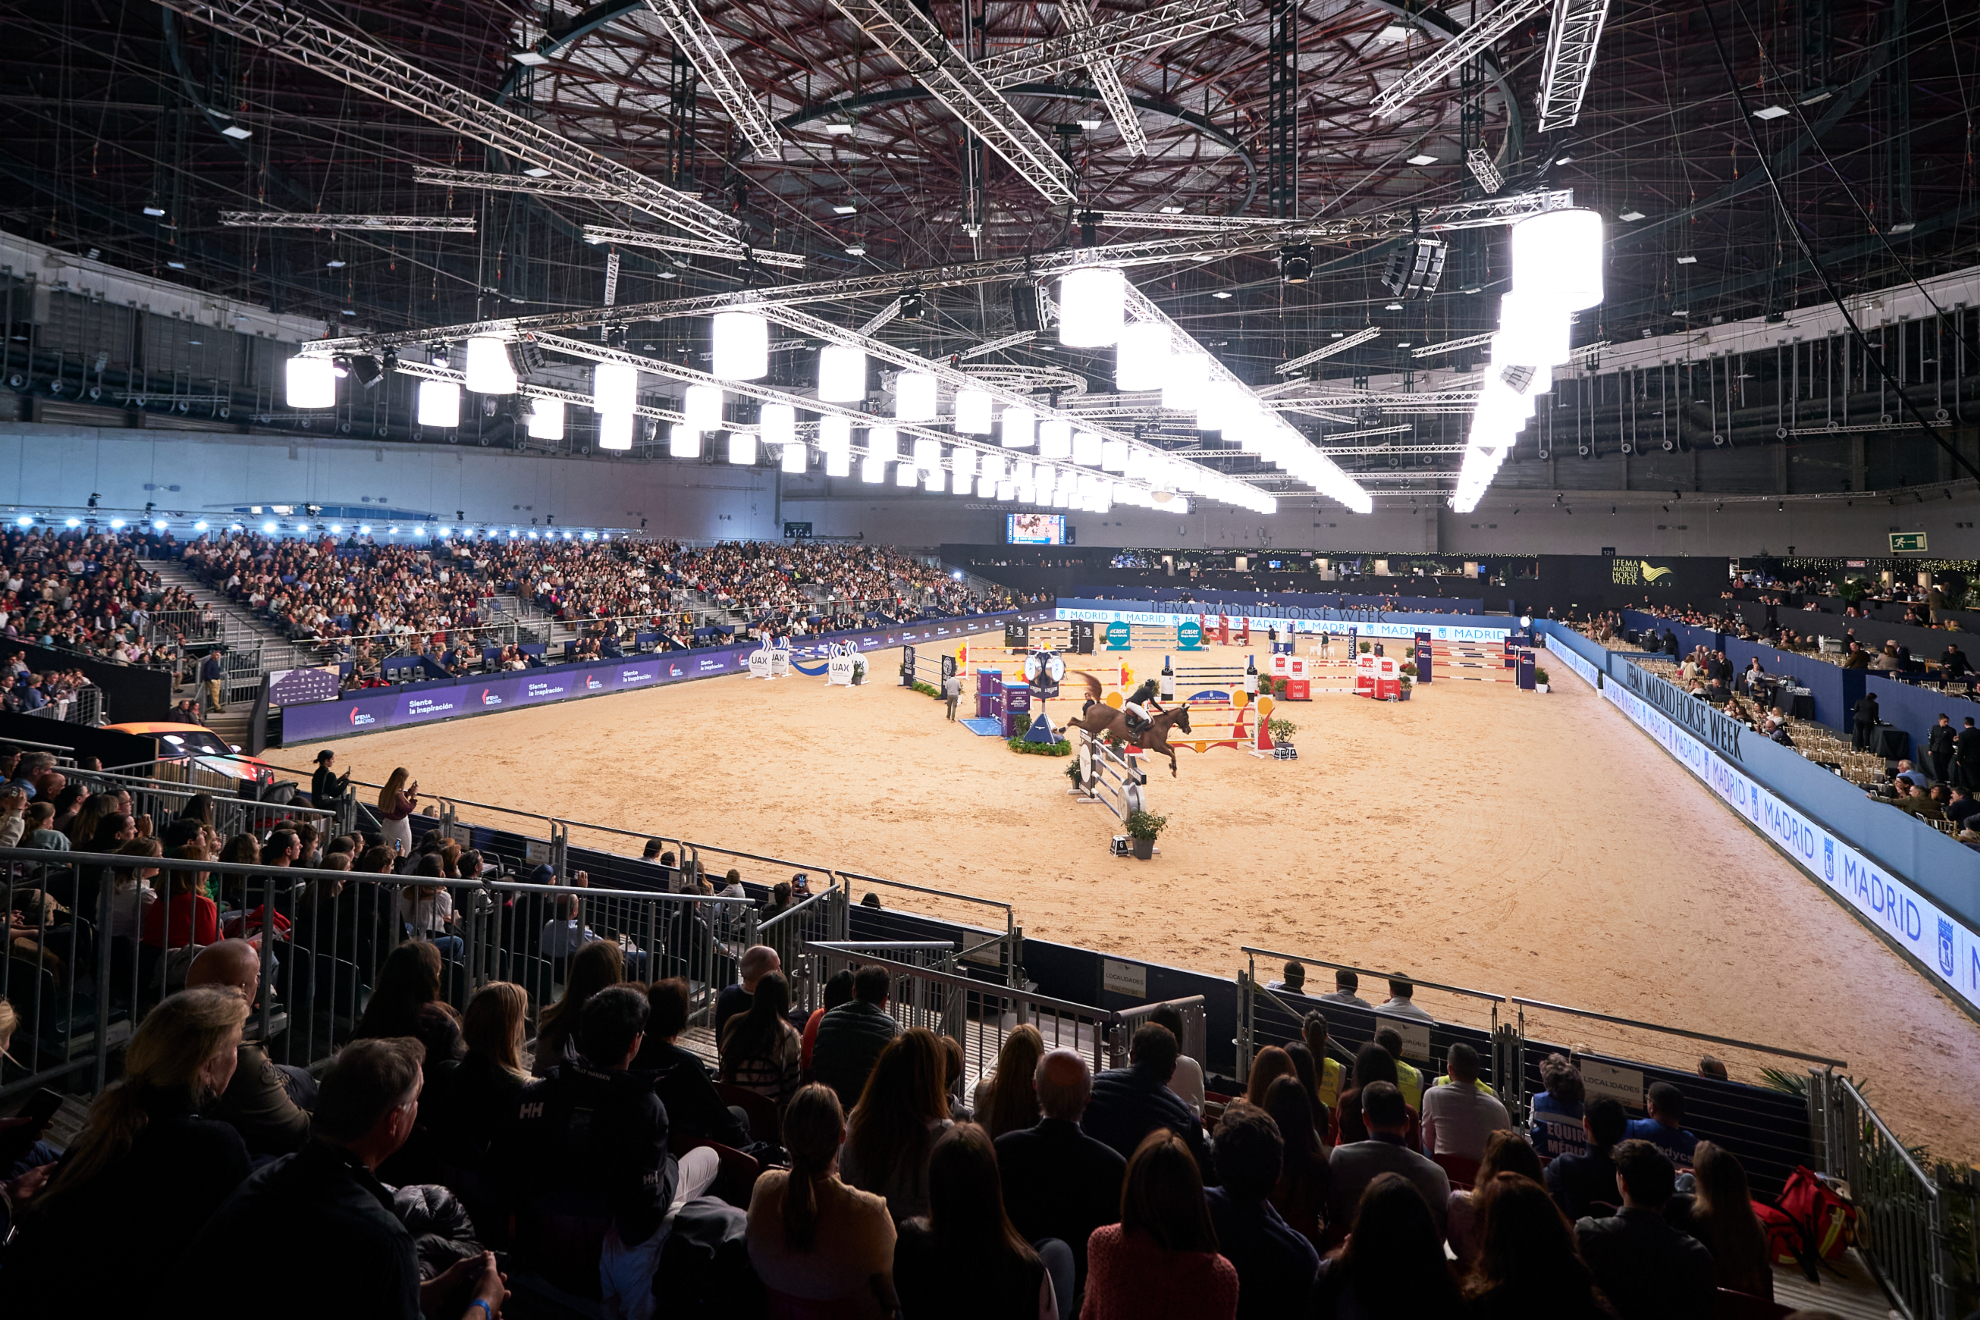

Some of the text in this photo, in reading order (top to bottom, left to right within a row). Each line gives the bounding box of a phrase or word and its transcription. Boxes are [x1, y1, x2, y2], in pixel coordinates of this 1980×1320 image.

[1612, 559, 1639, 567] IFEMA
[1612, 571, 1638, 580] HORSE
[1613, 578, 1638, 586] WEEK
[1152, 602, 1388, 624] IFEMA MADRID HORSE WEEK
[1070, 611, 1108, 620] MADRID
[1126, 613, 1166, 623] MADRID
[1454, 629, 1505, 640] MADRID
[751, 656, 768, 665] UAX
[832, 662, 850, 672] UAX
[534, 686, 564, 696] inspiración
[409, 699, 433, 708] Siente
[409, 702, 453, 715] la inspiración
[1626, 662, 1744, 763] IFEMA MADRID HORSE WEEK
[355, 718, 375, 726] MADRID
[1674, 730, 1700, 768] MADRID
[1712, 759, 1746, 806] MADRID
[1764, 797, 1815, 859] MADRID
[1844, 854, 1921, 942] MADRID
[1119, 841, 1124, 849] 6
[1105, 972, 1144, 986] LOCALIDADES
[587, 1070, 611, 1081] HANSEN
[1583, 1075, 1640, 1094] LOCALIDADES
[519, 1102, 544, 1119] HH
[643, 1170, 658, 1184] HH
